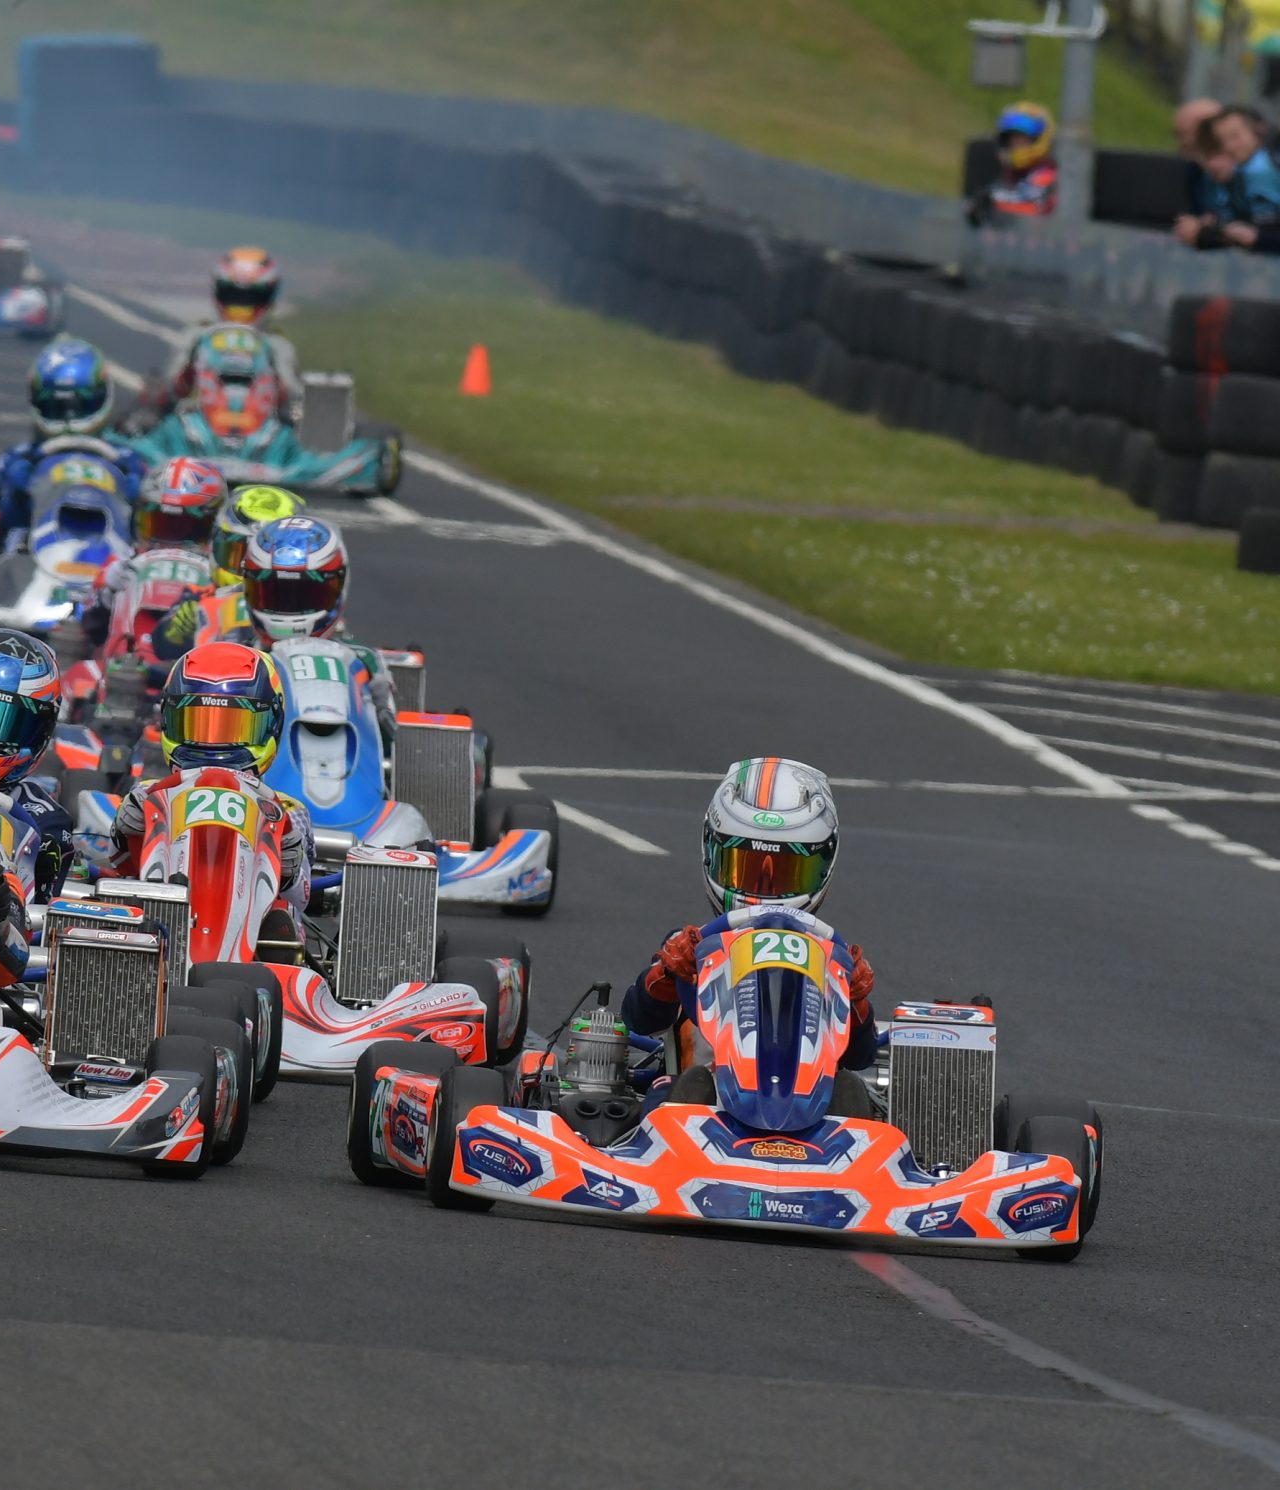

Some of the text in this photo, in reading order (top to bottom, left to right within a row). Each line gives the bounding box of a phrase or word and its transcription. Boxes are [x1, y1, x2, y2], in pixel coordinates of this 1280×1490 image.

[291, 656, 344, 682] 91
[201, 696, 228, 707] Wera
[185, 789, 246, 827] 26
[751, 840, 780, 852] Wera
[754, 932, 808, 965] 29
[419, 992, 461, 1010] GILLARD
[436, 1027, 463, 1040] MBR
[77, 1064, 132, 1078] New-Line
[754, 1142, 804, 1152] demon
[474, 1144, 526, 1174] FUSION
[752, 1149, 807, 1160] tweeks
[764, 1200, 804, 1214] Wera
[1015, 1199, 1063, 1218] FUSION
